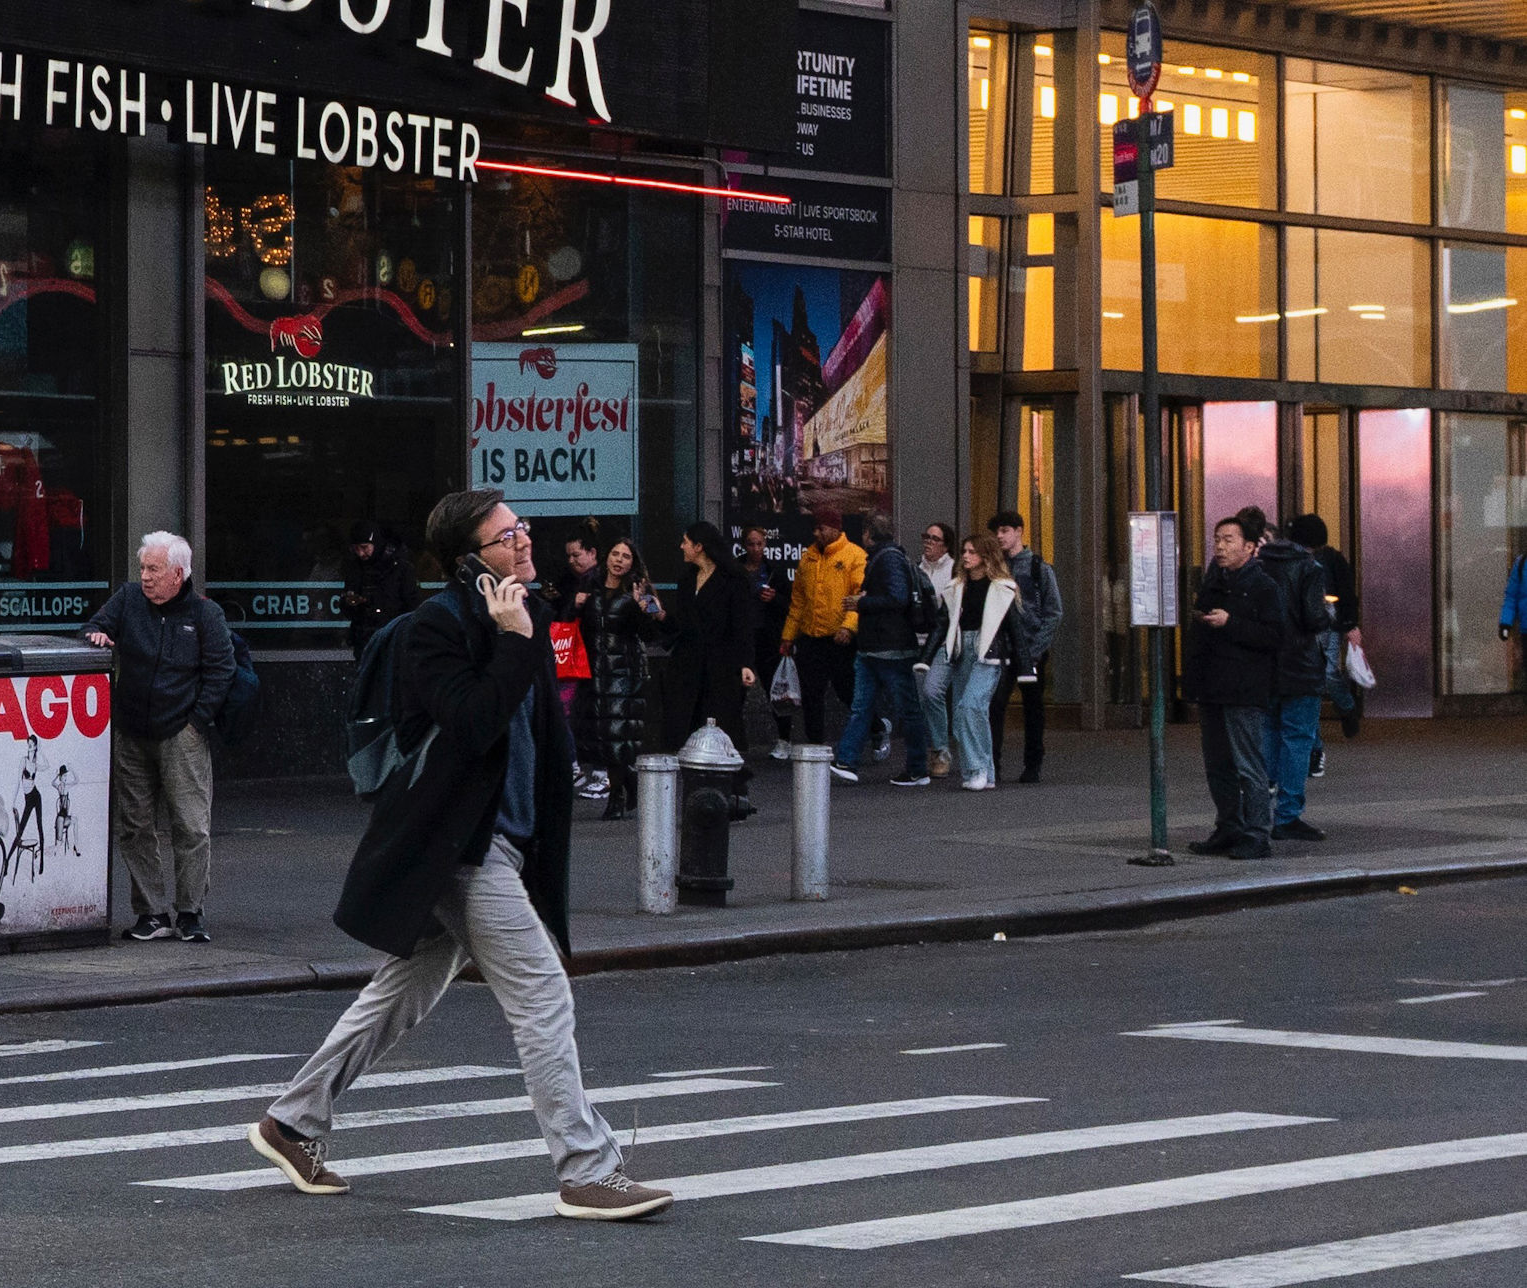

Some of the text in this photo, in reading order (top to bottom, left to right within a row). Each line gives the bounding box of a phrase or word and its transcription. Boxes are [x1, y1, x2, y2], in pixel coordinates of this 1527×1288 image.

[45, 59, 146, 137] FISH
[186, 78, 277, 156] LIVE
[298, 100, 481, 184] LOBSTER
[801, 103, 852, 120] BUSINESSES
[1150, 116, 1163, 136] M7
[802, 142, 814, 155] US
[1150, 144, 1169, 165] M20
[727, 198, 877, 223] ENTERTAINMENT LIVE SPORTSBOOK
[774, 224, 833, 241] 5-STAR HOTEL
[222, 356, 374, 398] RED LOBSTER
[247, 394, 350, 407] FRESH FISH LIVE LOBSTER
[482, 447, 596, 484] IS BACK!
[0, 595, 84, 616] SCALLOPS
[252, 594, 309, 615] CRAB
